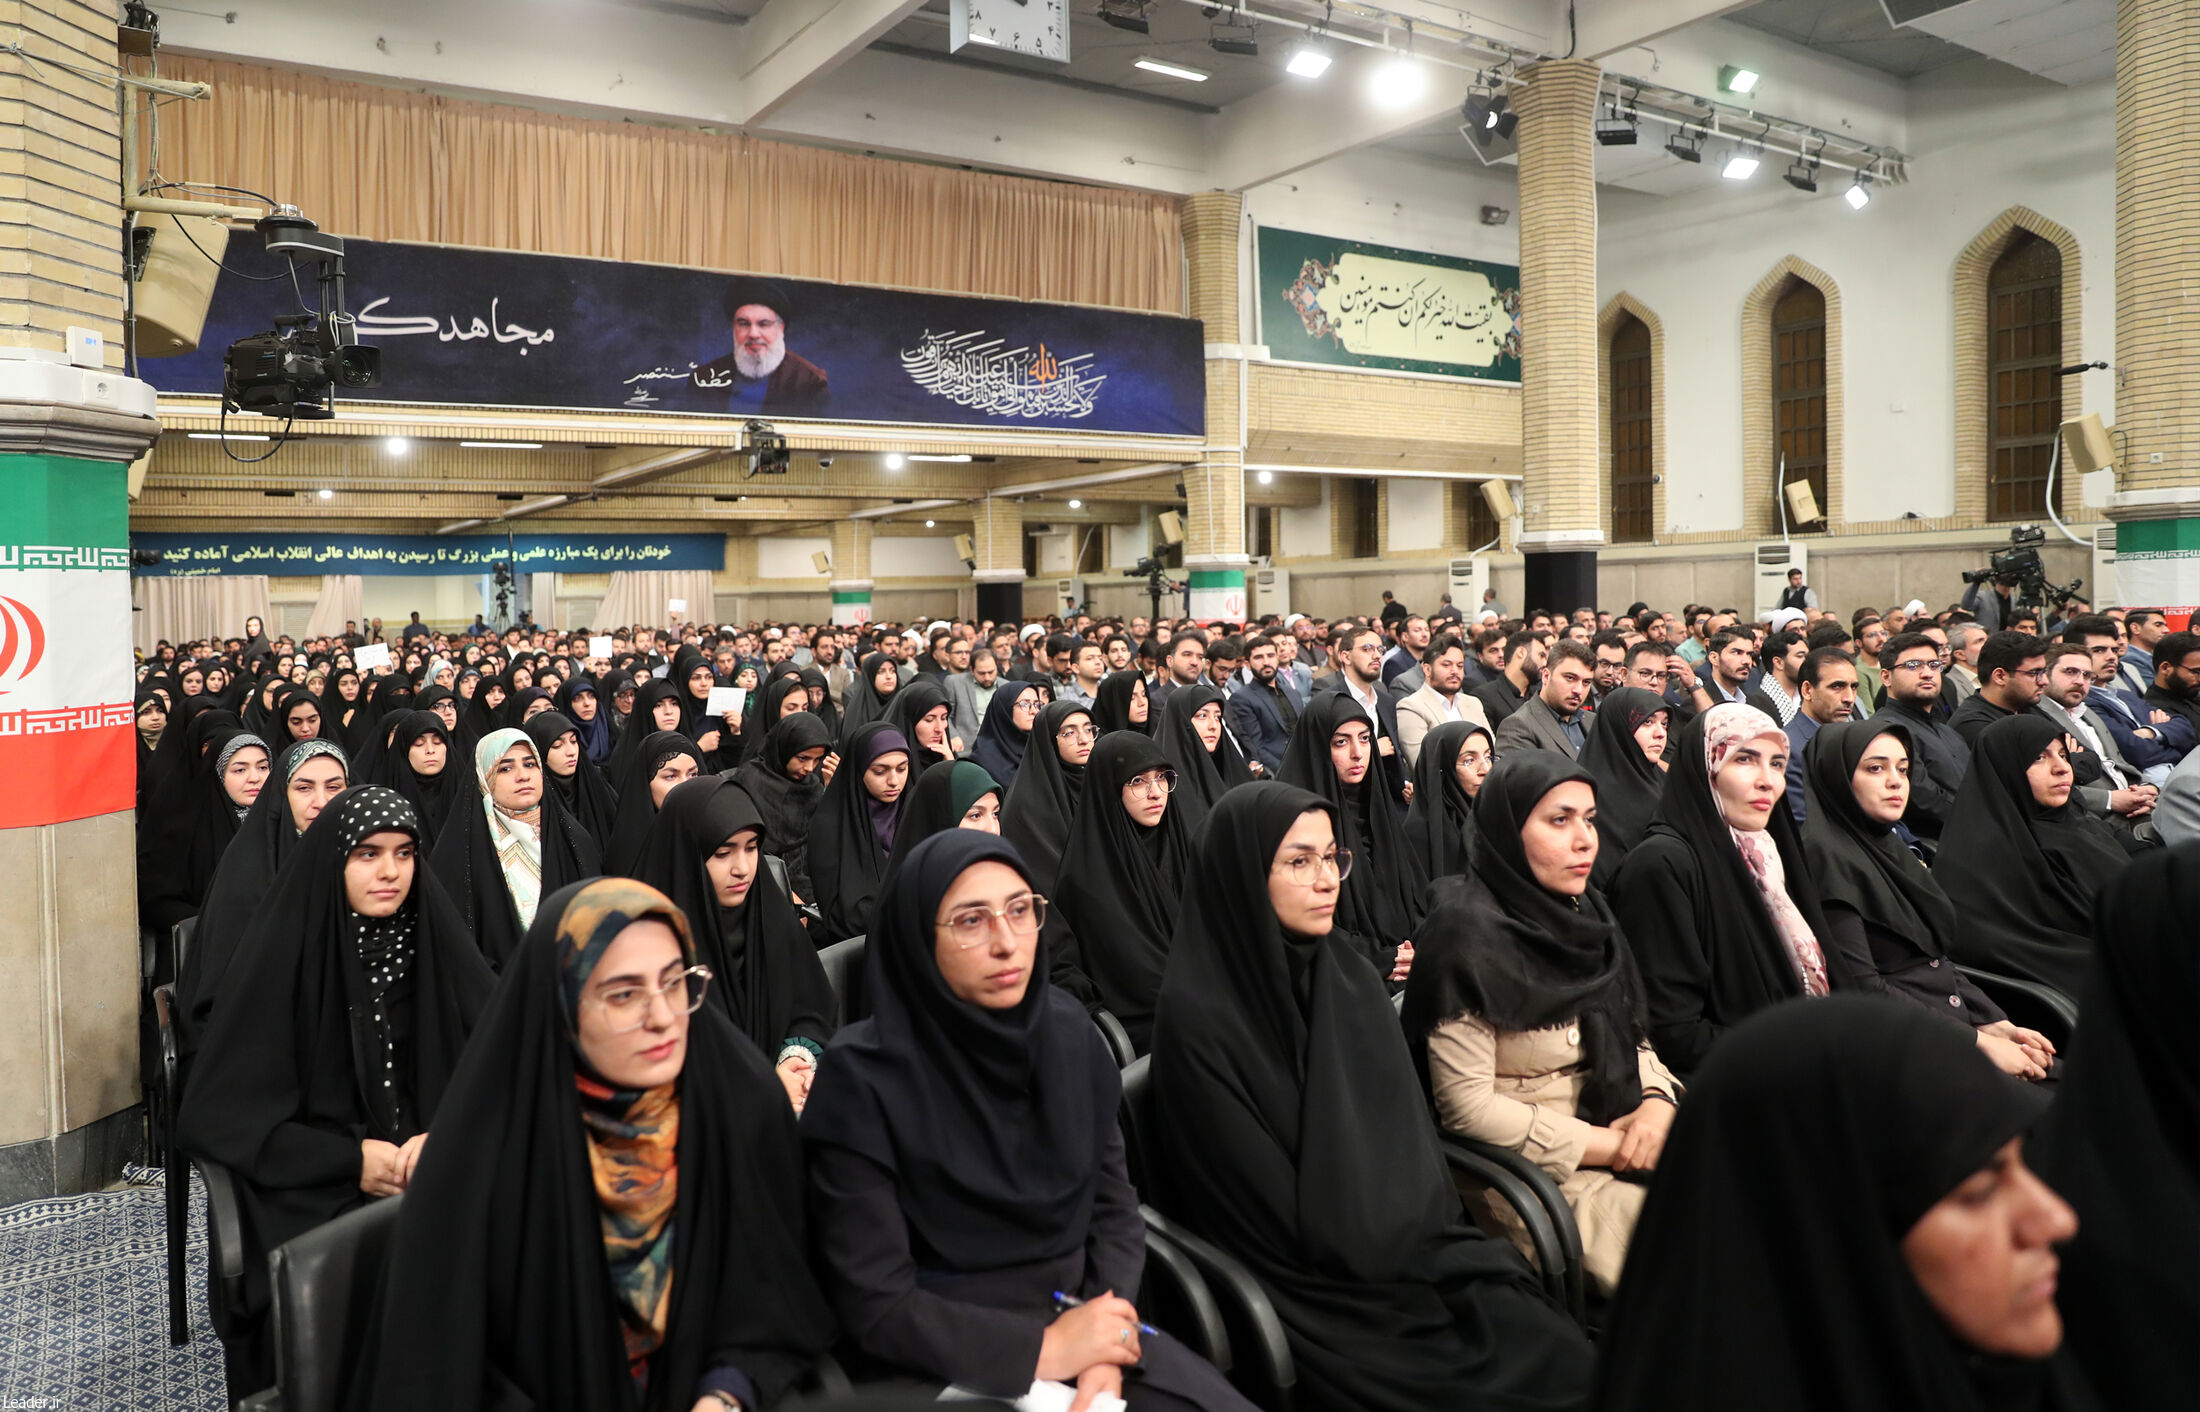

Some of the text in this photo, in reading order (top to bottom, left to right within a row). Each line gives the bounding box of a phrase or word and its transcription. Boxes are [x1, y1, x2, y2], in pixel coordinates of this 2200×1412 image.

[438, 297, 556, 358] مجاهد
[163, 547, 191, 561] کنید
[194, 545, 229, 561] آماده
[232, 545, 273, 563] اسلامی
[276, 546, 312, 563] انقلاب
[314, 546, 343, 563] عالی
[347, 546, 383, 561] اهداف
[385, 549, 397, 563] به
[399, 550, 437, 564] رسیدن
[438, 548, 447, 561] تا
[448, 548, 479, 563] بزرگ
[481, 547, 509, 563] عملی
[518, 547, 546, 562] علمی
[548, 546, 580, 561] مبارزه
[582, 546, 599, 560] یک
[601, 546, 623, 562] برای
[625, 545, 635, 561] را
[636, 545, 672, 560] خودتان
